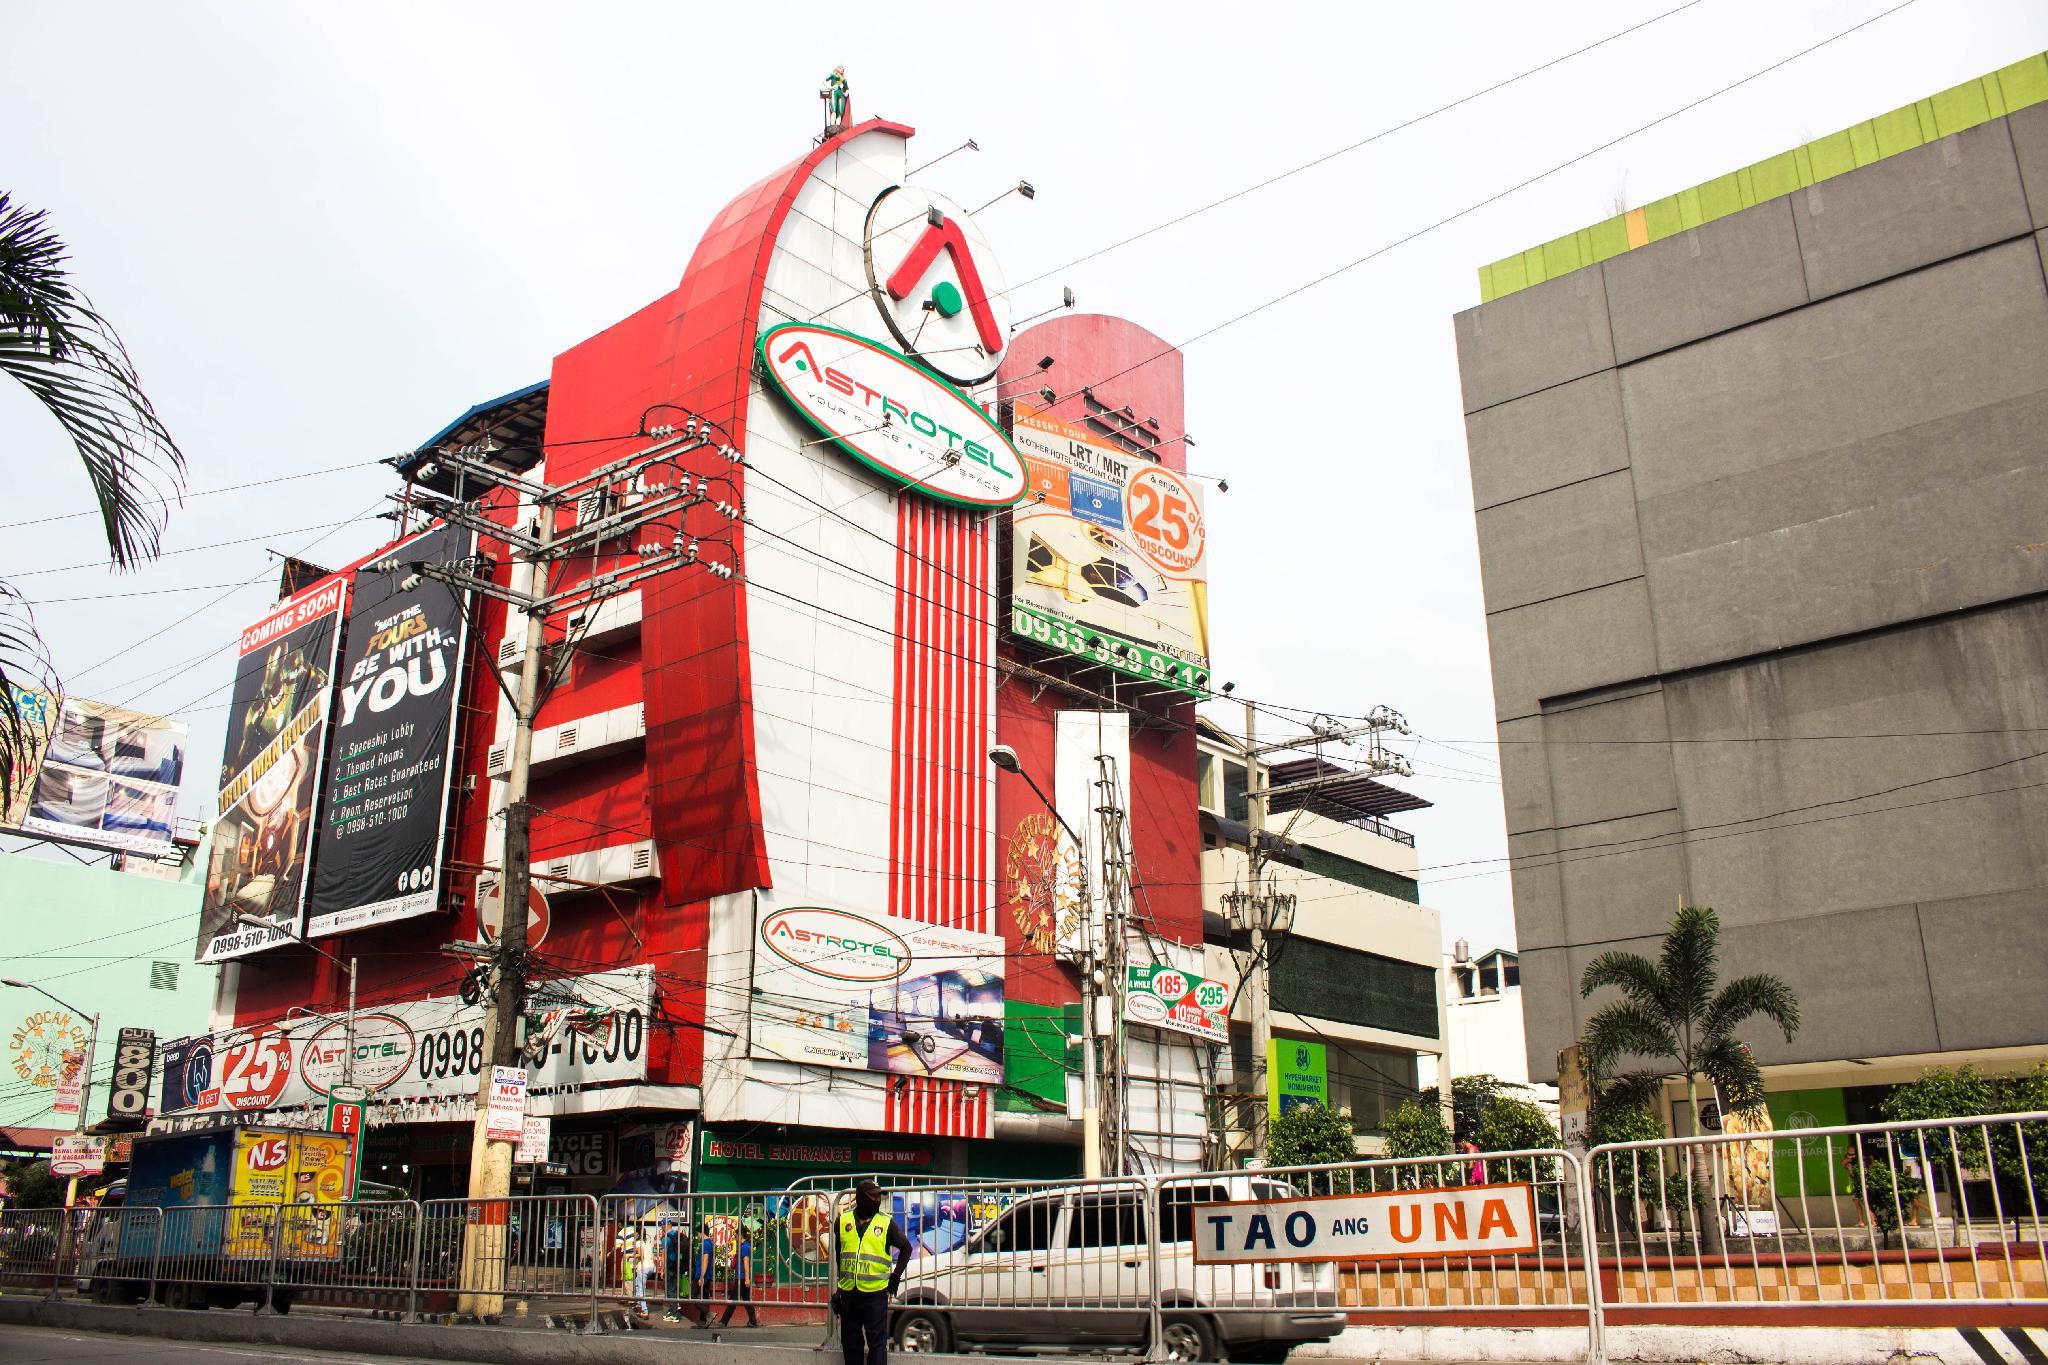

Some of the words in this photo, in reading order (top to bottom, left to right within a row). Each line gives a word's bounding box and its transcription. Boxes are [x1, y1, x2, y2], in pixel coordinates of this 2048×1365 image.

[779, 341, 1014, 480] ASTROTEL
[1016, 414, 1060, 434] PRESENT
[1062, 425, 1088, 441] YOUR
[807, 391, 848, 416] YOUR
[959, 468, 1001, 494] SPACE
[1025, 438, 1050, 455] OTHER
[1050, 448, 1073, 464] HOTEL
[1073, 459, 1107, 480] DISCOUNT
[1107, 475, 1126, 488] CARD
[1069, 440, 1093, 463] LRT
[1103, 456, 1129, 480] MRT
[1158, 479, 1180, 495] enjoy
[241, 610, 295, 650] COMING
[297, 586, 338, 622] SOON
[401, 604, 422, 620] THE
[365, 613, 428, 657] FOURS
[350, 653, 381, 682] BE
[1156, 641, 1181, 661] STAR
[1183, 649, 1208, 668] TREK
[349, 731, 388, 758] Spaceship
[390, 721, 415, 741] Lobby
[218, 771, 251, 815] IRON
[251, 740, 281, 786] MAN
[282, 696, 321, 753] ROOM
[346, 754, 376, 777] Themed
[377, 748, 404, 767] Rooms
[343, 781, 362, 799] Best
[364, 775, 388, 795] Rates
[390, 754, 441, 783] Guaranteed
[340, 803, 361, 820] Room
[364, 788, 414, 813] Reservation
[336, 824, 345, 840] @
[346, 804, 408, 835] 0998-510-1000
[212, 921, 293, 955] 0998-510-1000
[771, 919, 899, 960] ASTROTEL
[1156, 975, 1181, 994] 185
[1200, 986, 1223, 1006] 295
[530, 993, 583, 1008] Reservation
[1174, 1003, 1187, 1022] 10
[9, 1011, 71, 1050] CALOOCAN
[1186, 1014, 1203, 1025] STAY
[122, 1028, 154, 1039] CUT
[166, 1051, 180, 1063] beep
[500, 1085, 519, 1096] NO
[1285, 1073, 1322, 1084] HYPERMARKET
[205, 1092, 219, 1105] GET
[236, 1095, 272, 1107] DISCOUNT
[490, 1103, 523, 1111] UNLOADING
[492, 1096, 523, 1104] LOADING
[342, 1106, 353, 1133] MOT
[1571, 1117, 1578, 1128] 24
[709, 1140, 765, 1160] HOTEL
[769, 1145, 852, 1163] ENTRANCE
[871, 1150, 894, 1161] THIS
[896, 1152, 916, 1161] WAY
[1207, 1210, 1317, 1252] TAO
[1331, 1217, 1369, 1237] ANG
[1388, 1198, 1518, 1244] UNA
